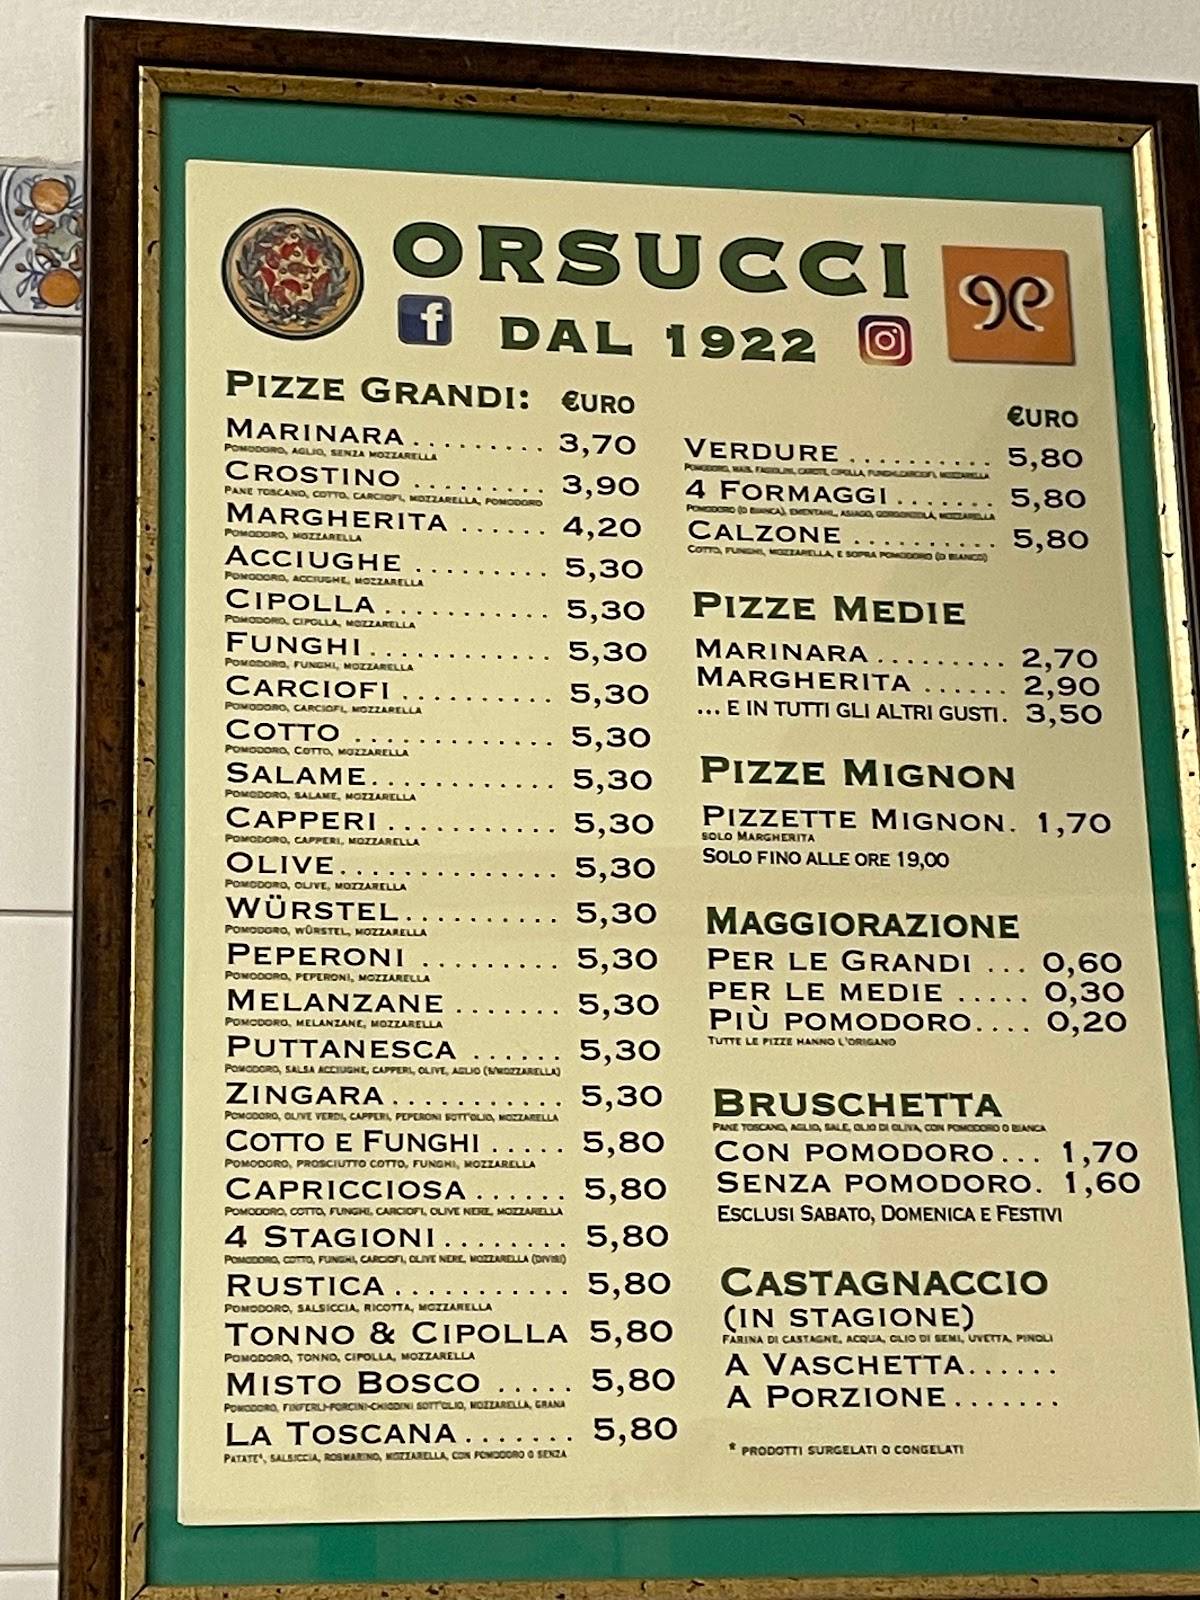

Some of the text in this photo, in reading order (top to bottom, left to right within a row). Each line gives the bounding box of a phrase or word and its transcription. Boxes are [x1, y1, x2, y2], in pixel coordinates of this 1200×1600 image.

[392, 221, 910, 299] ORSUCCI
[499, 315, 816, 364] DAL 1922
[225, 369, 345, 402] PIZZE
[360, 376, 529, 410] GRANDI:
[226, 417, 637, 456] MARINARA 3,70
[683, 437, 1083, 473] VERDURE 5,80
[225, 460, 640, 500] CROSTINO 3,90
[685, 479, 1087, 513] 4 FORMAGGI 5,80
[226, 501, 642, 542] MARGHERITA 4,20
[688, 519, 1089, 554] CALZONE 5,80
[224, 544, 401, 572] ACCIUGHE
[225, 588, 645, 625] CIPOLLA 5,30
[692, 591, 966, 626] PIZZE MEDIE
[226, 631, 360, 657] FUNGHI
[695, 638, 1098, 674] MARINARA 2,70
[226, 674, 388, 700] CARCIOFI
[697, 665, 1100, 701] MARGHERITA 2,90
[727, 699, 741, 716] E
[746, 699, 768, 717] IN
[773, 700, 830, 719] TUTTI
[835, 702, 870, 720] GLI
[875, 703, 933, 721] ALTRI
[1025, 703, 1103, 729] 3,50
[226, 718, 339, 742] COTTO
[226, 761, 366, 786] SALAME
[699, 755, 1015, 790] PIZZE MIGNON
[226, 806, 375, 831] CAPPERI
[702, 804, 857, 829] PIZZETTE
[1038, 811, 1111, 839] 1,70
[701, 830, 816, 843] SOLO MARGHERITA
[226, 851, 334, 875] OLIVE
[702, 847, 950, 872] SOLO FINO ALLE ORE 19,00
[225, 894, 657, 930] WÜRSTEL 5,30
[706, 906, 1020, 939] MAGGIORAZIONE
[227, 942, 404, 967] PEPERONI
[707, 947, 1123, 979] PER LE GRANDI 0,60
[227, 988, 660, 1021] MELANZANE 5,30
[708, 980, 1125, 1009] PER LE MEDIE 0,30
[709, 1005, 1127, 1038] PIÙ POMODORO 0,20
[227, 1035, 661, 1067] PUTTANESCA 5,30
[707, 1035, 742, 1046] TUTTE
[745, 1036, 759, 1046] LE
[762, 1037, 793, 1047] PIZZE
[796, 1037, 836, 1046] HANNO
[225, 1081, 384, 1106] ZINGARA
[713, 1088, 1003, 1118] BRUSCHETTA
[225, 1128, 665, 1159] COTTO E FUNGHI 5,80
[714, 1140, 1138, 1169] CON POMODORO 1,70
[226, 1176, 466, 1201] CAPRICCIOSA
[716, 1170, 832, 1194] SENZA
[1065, 1170, 1141, 1199] 1,60
[717, 1204, 1063, 1226] ESCLUSI SABATO, DOMENICA E FESTIVI
[224, 1224, 669, 1253] 4 STAGIONI 5,80
[227, 1273, 385, 1297] RUSTICA
[720, 1266, 1049, 1298] CASTAGNACCIO
[723, 1303, 974, 1334] (IN STAGIONE)
[224, 1319, 673, 1349] TONNO & CIPOLLA 5,80
[724, 1352, 965, 1377] A VASCHETTA
[226, 1370, 480, 1397] MISTO BOSCO
[726, 1384, 946, 1409] A PORZIONE
[226, 1416, 678, 1447] LA TOSCANA 5,80
[741, 1445, 803, 1457] PRODOTTI
[807, 1444, 878, 1456] SURGELATI
[893, 1444, 965, 1456] CONGELATI
